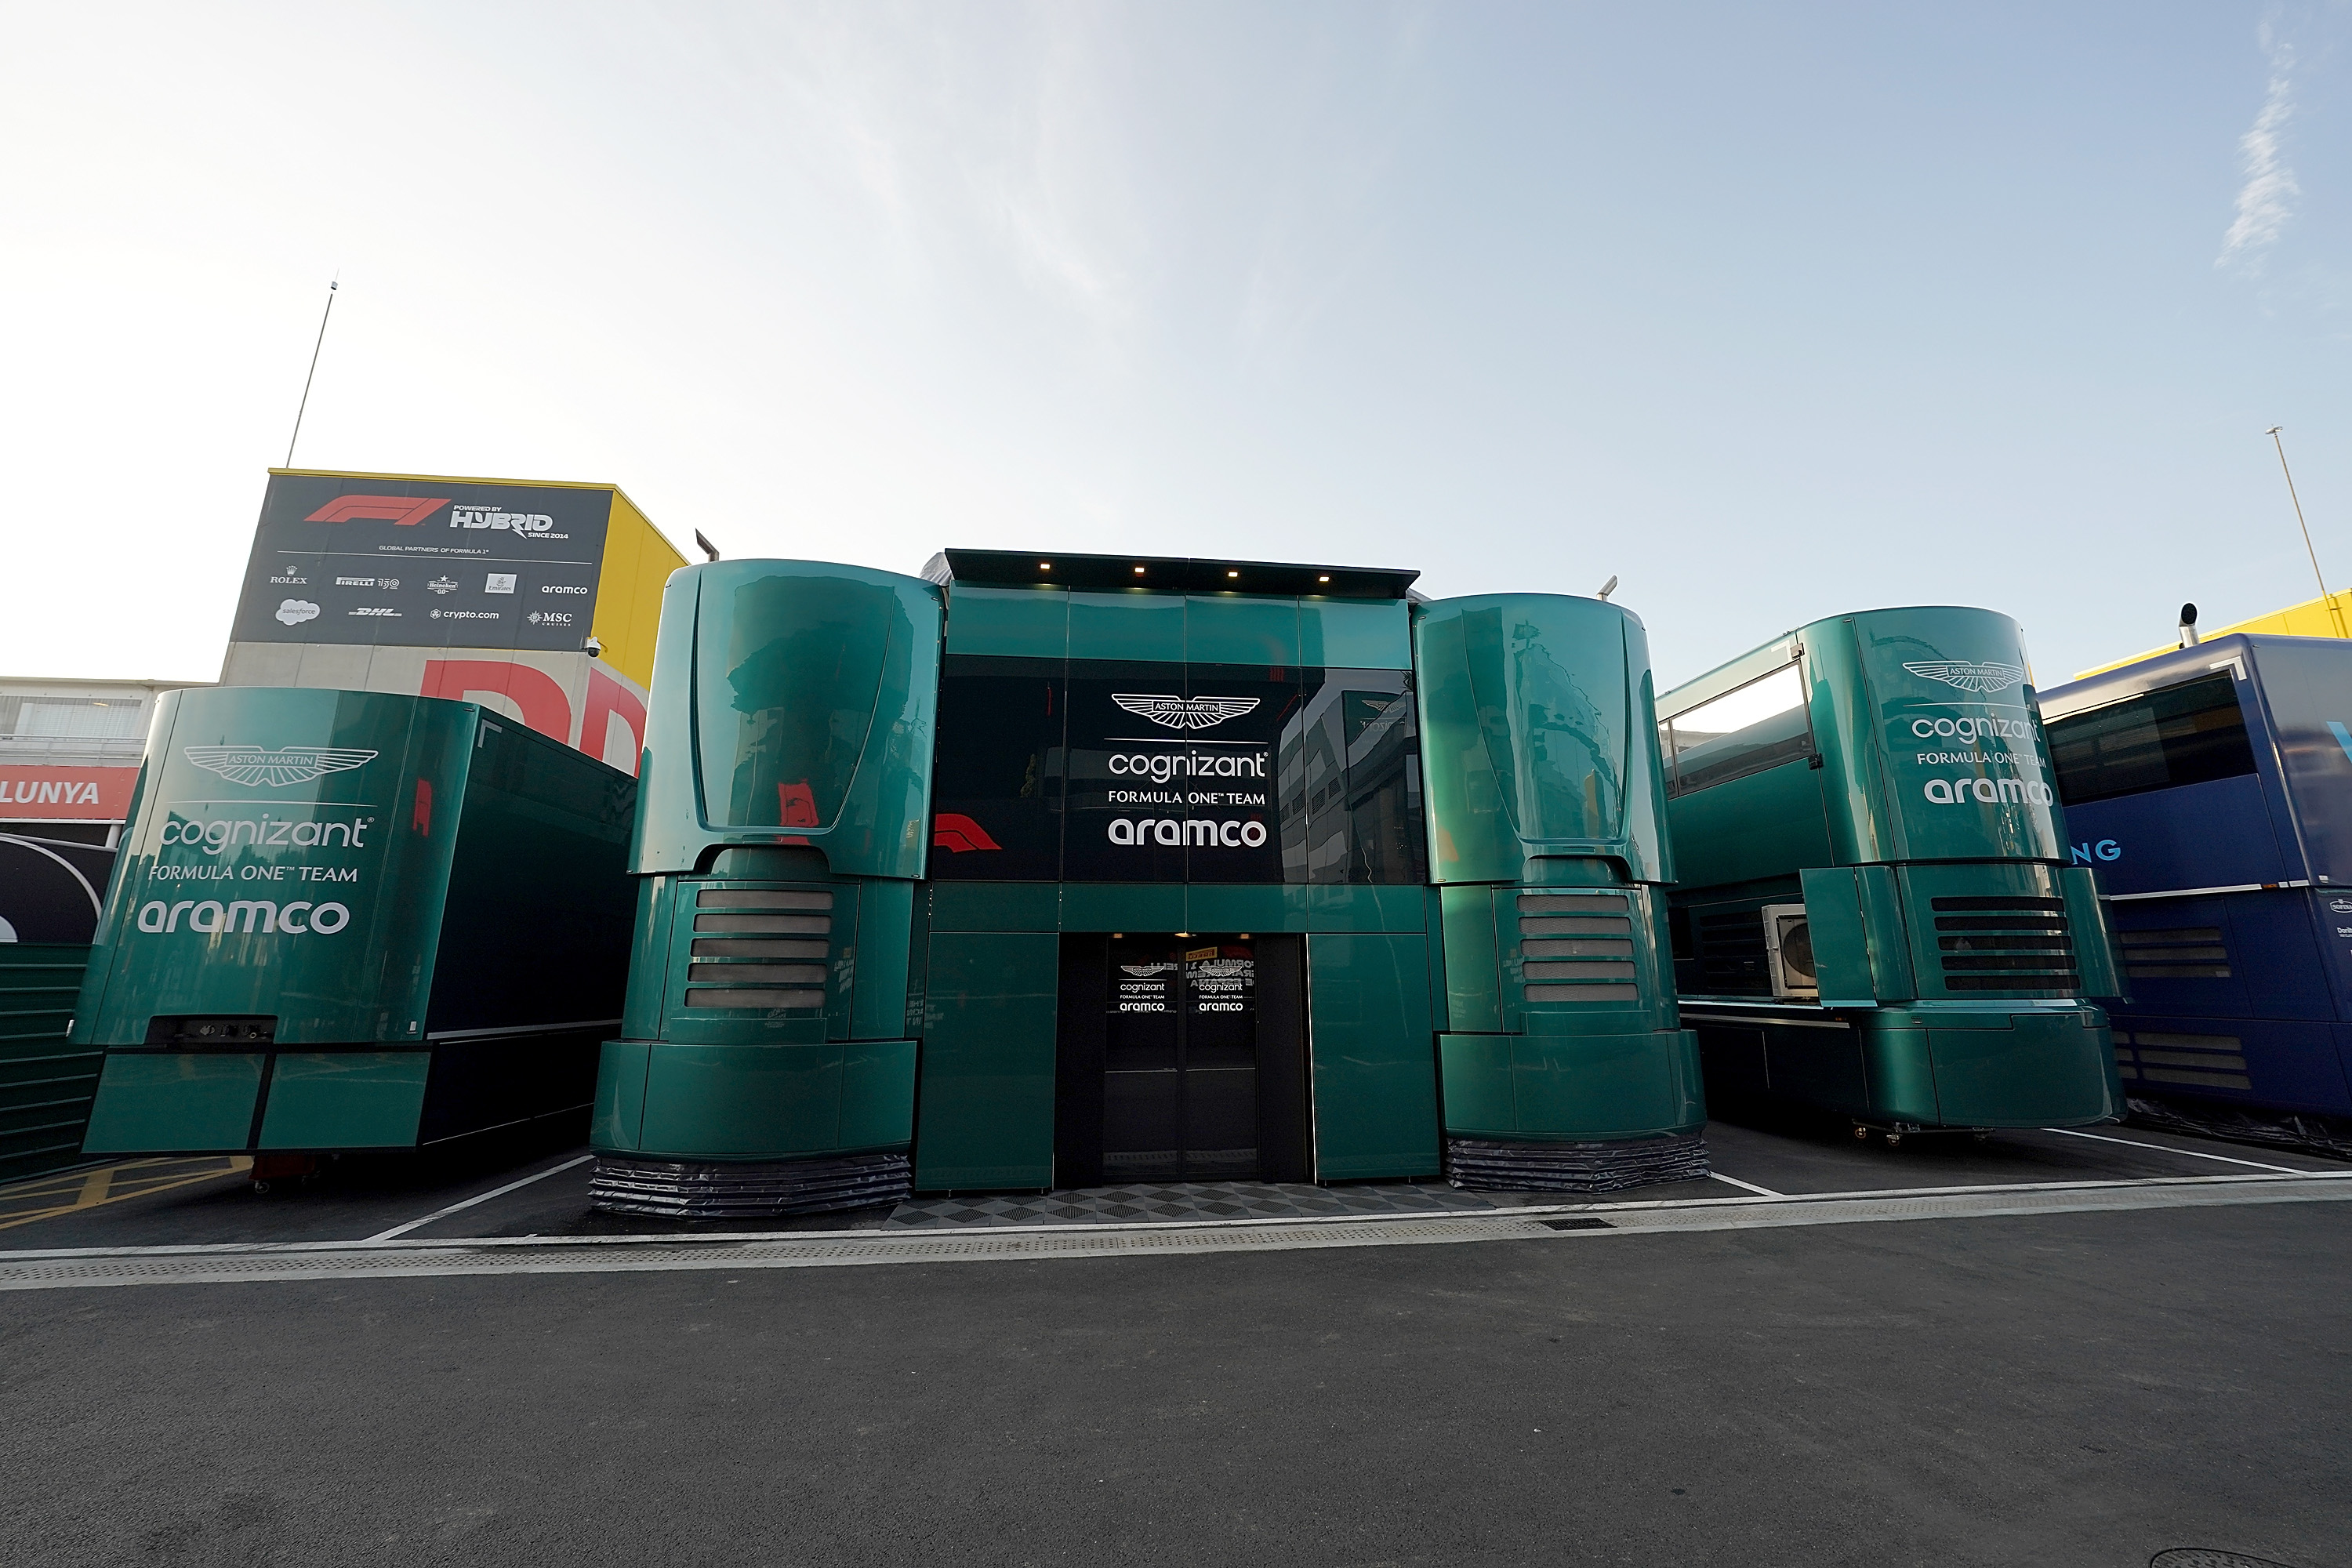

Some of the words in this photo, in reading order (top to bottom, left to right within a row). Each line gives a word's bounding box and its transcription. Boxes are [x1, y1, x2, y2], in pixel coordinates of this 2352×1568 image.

[449, 511, 554, 539] HYBRID
[270, 576, 307, 585] ROLEX
[336, 576, 375, 586] PIRELLI
[541, 585, 588, 594] aramco
[355, 608, 394, 616] DHL
[443, 610, 499, 620] crypto.com
[543, 612, 572, 622] MSC
[1949, 667, 1976, 676] ASTON
[1976, 668, 2003, 677] MARTIN
[1155, 702, 1185, 711] ASTON
[1185, 703, 1218, 712] MARTIN
[228, 754, 267, 764] ASTON
[267, 754, 314, 766] MARTIN
[1917, 751, 1991, 765] FORMULA
[2024, 754, 2046, 768] TEAM
[1109, 790, 1183, 804] FORMULA
[1227, 793, 1265, 805] TEAM
[1924, 778, 2053, 808] aramco
[1108, 818, 1267, 848] aramco
[148, 865, 234, 881] FORMULA
[299, 866, 358, 882] TEAM
[137, 900, 350, 935] aramco
[1120, 982, 1165, 993] cognizant
[1199, 982, 1243, 993] cognizant
[1120, 1003, 1165, 1011] aramco
[1199, 1003, 1243, 1011] aramco
